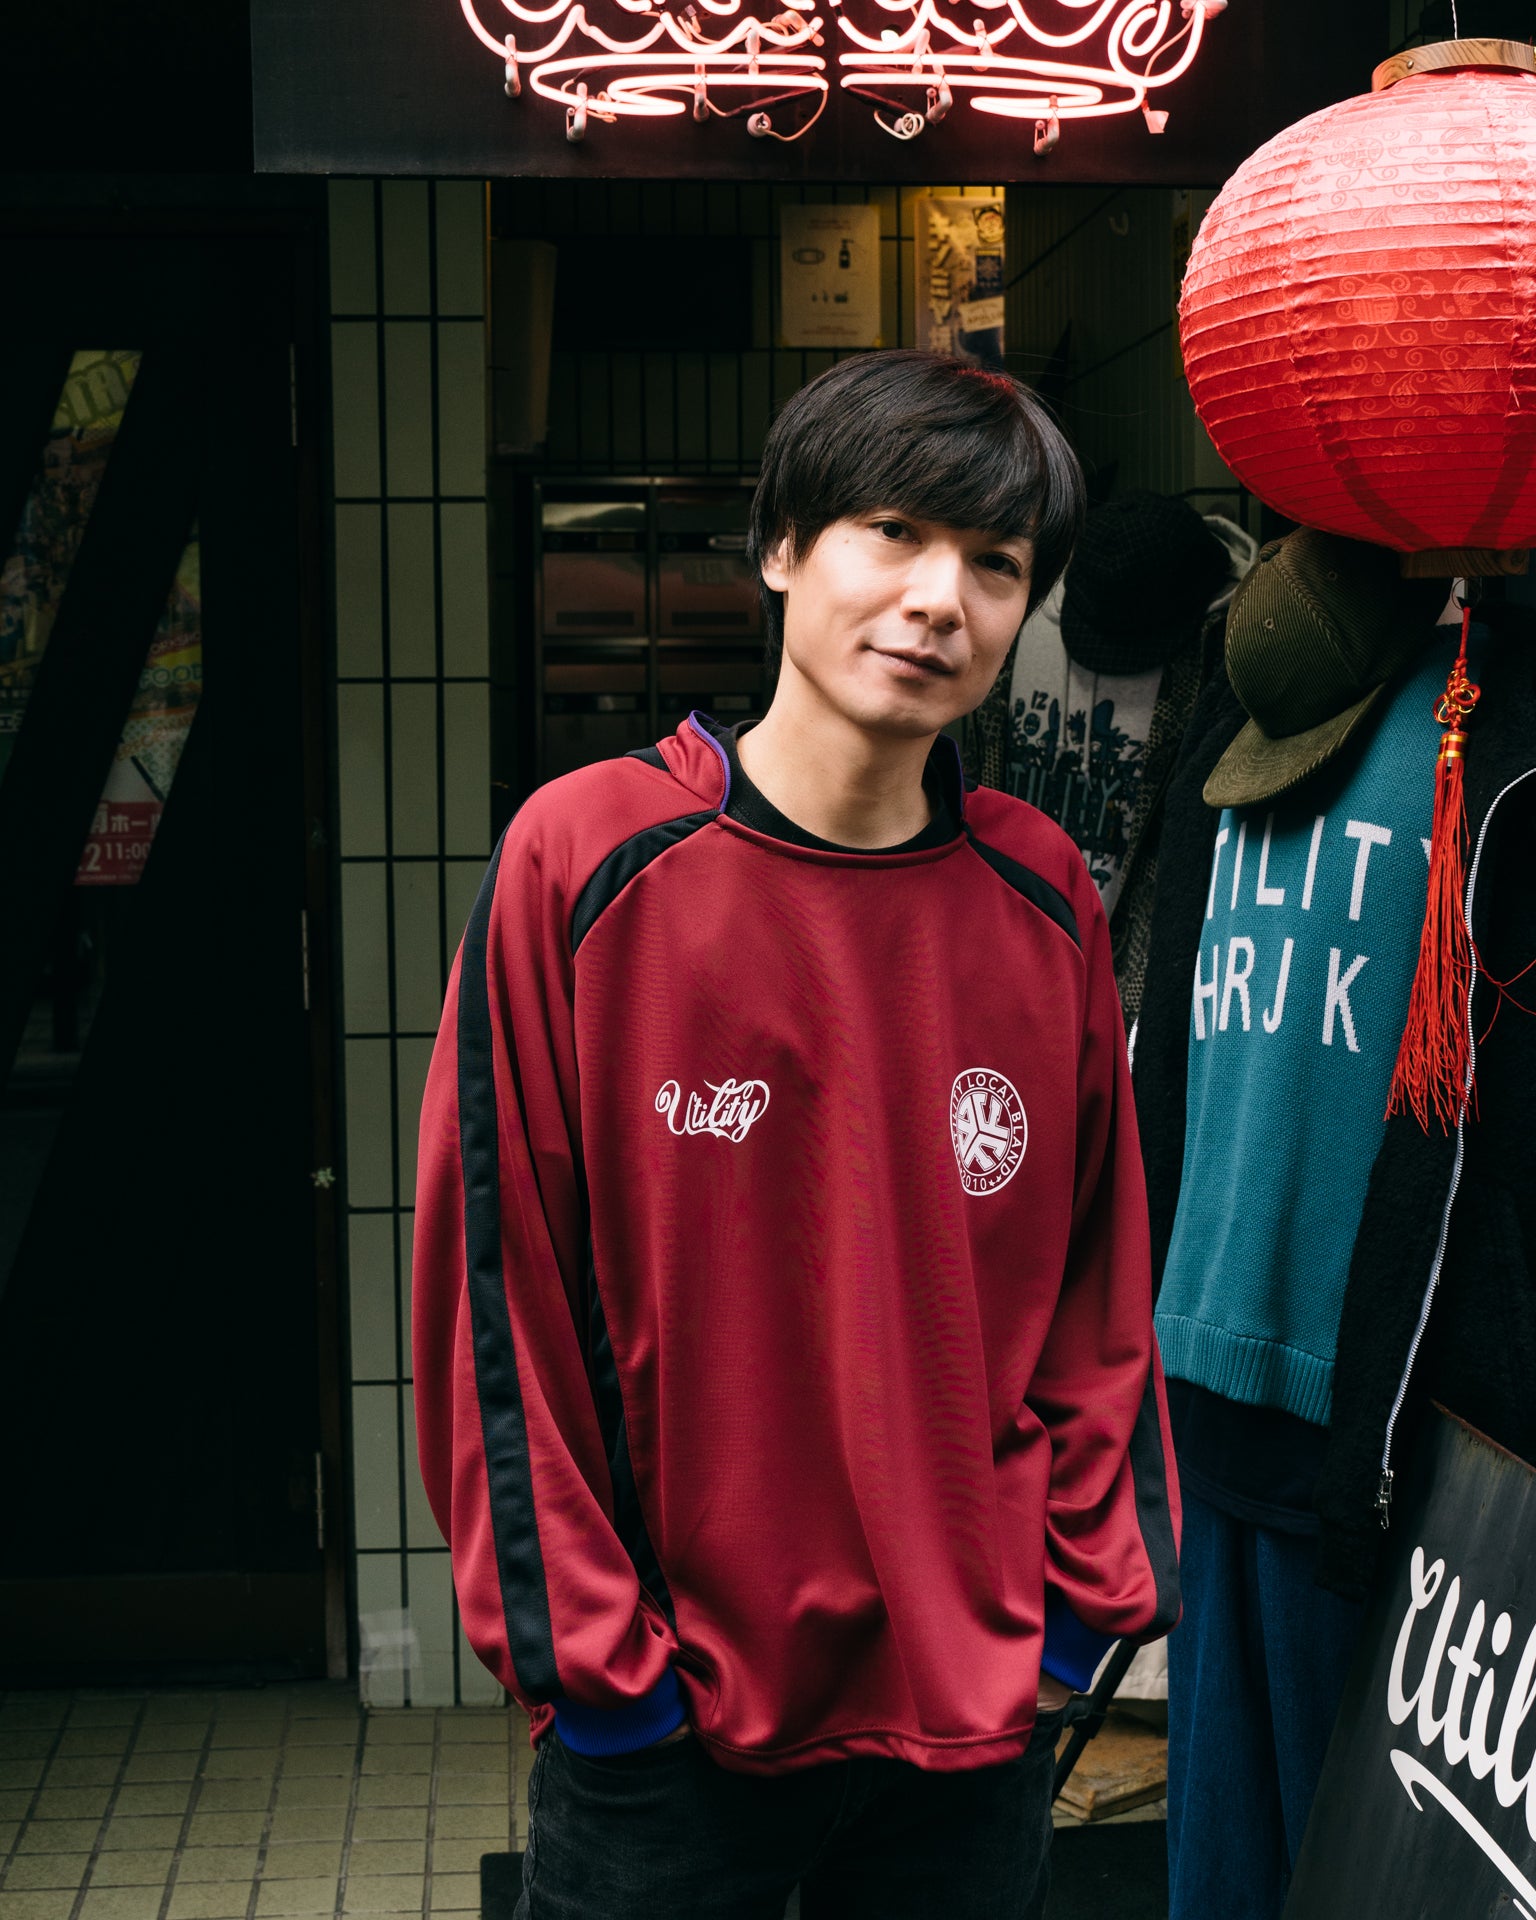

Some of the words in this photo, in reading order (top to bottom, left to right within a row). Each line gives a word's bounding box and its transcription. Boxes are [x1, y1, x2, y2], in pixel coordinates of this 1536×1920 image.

[1207, 812, 1432, 922] TILIT
[654, 1077, 771, 1144] Utility
[967, 1073, 1014, 1107] LOCAL
[999, 1111, 1024, 1177] BLAND
[1387, 1545, 1536, 1842] Util
